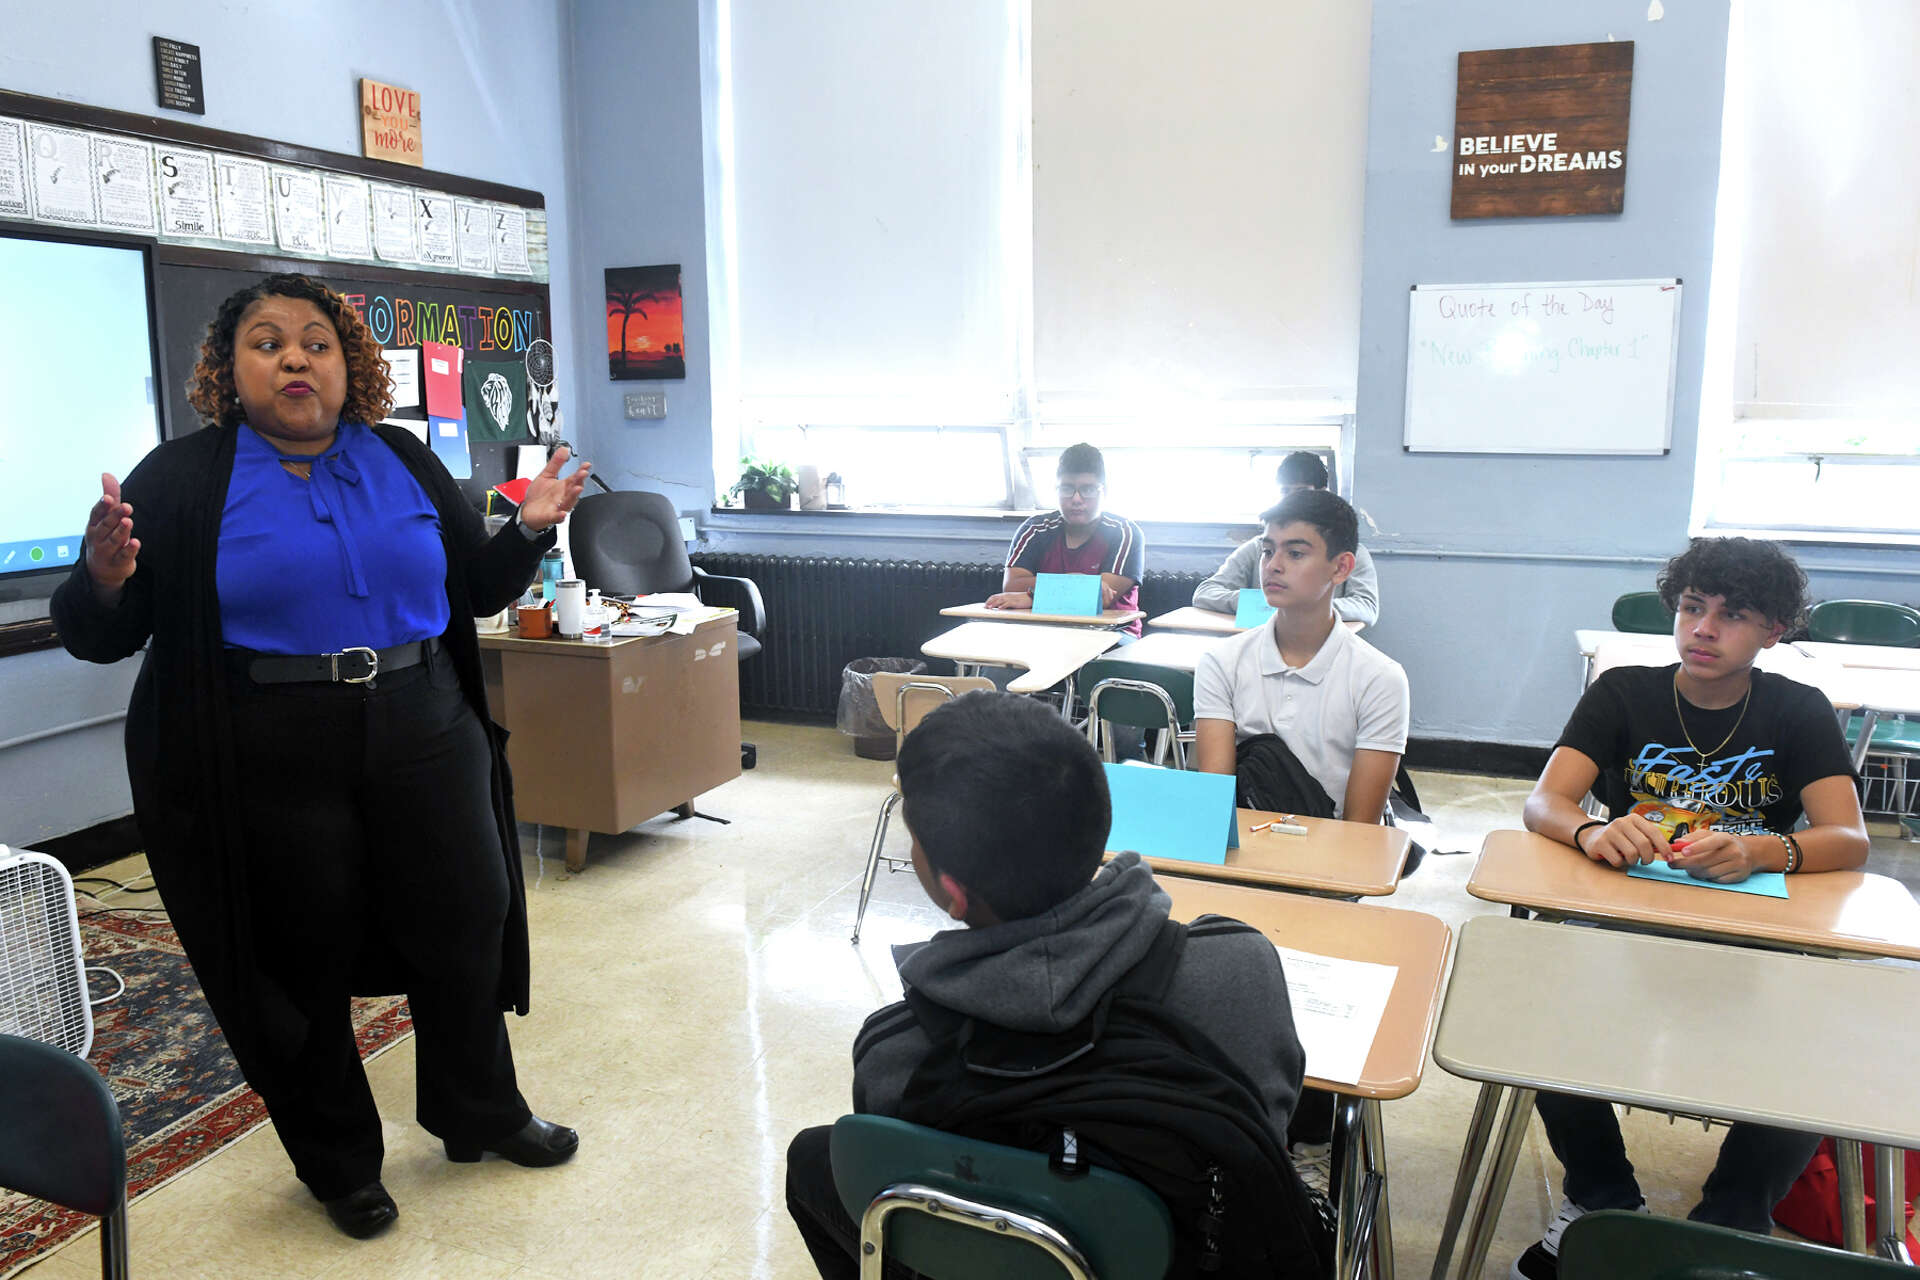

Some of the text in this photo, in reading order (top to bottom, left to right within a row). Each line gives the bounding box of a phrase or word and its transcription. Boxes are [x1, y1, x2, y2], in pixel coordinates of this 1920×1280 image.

[372, 84, 416, 118] LOVE
[381, 114, 408, 131] YOU
[375, 129, 416, 152] more
[1460, 133, 1558, 156] BELIEVE
[162, 156, 178, 177] S
[221, 165, 236, 186] T
[1458, 150, 1623, 178] IN your DREAMS
[278, 177, 291, 197] U
[420, 199, 433, 218] X
[175, 220, 204, 231] Simile
[1439, 291, 1615, 325] Quote of the Day
[337, 293, 532, 352] FORMATION
[1568, 336, 1621, 359] Chapter
